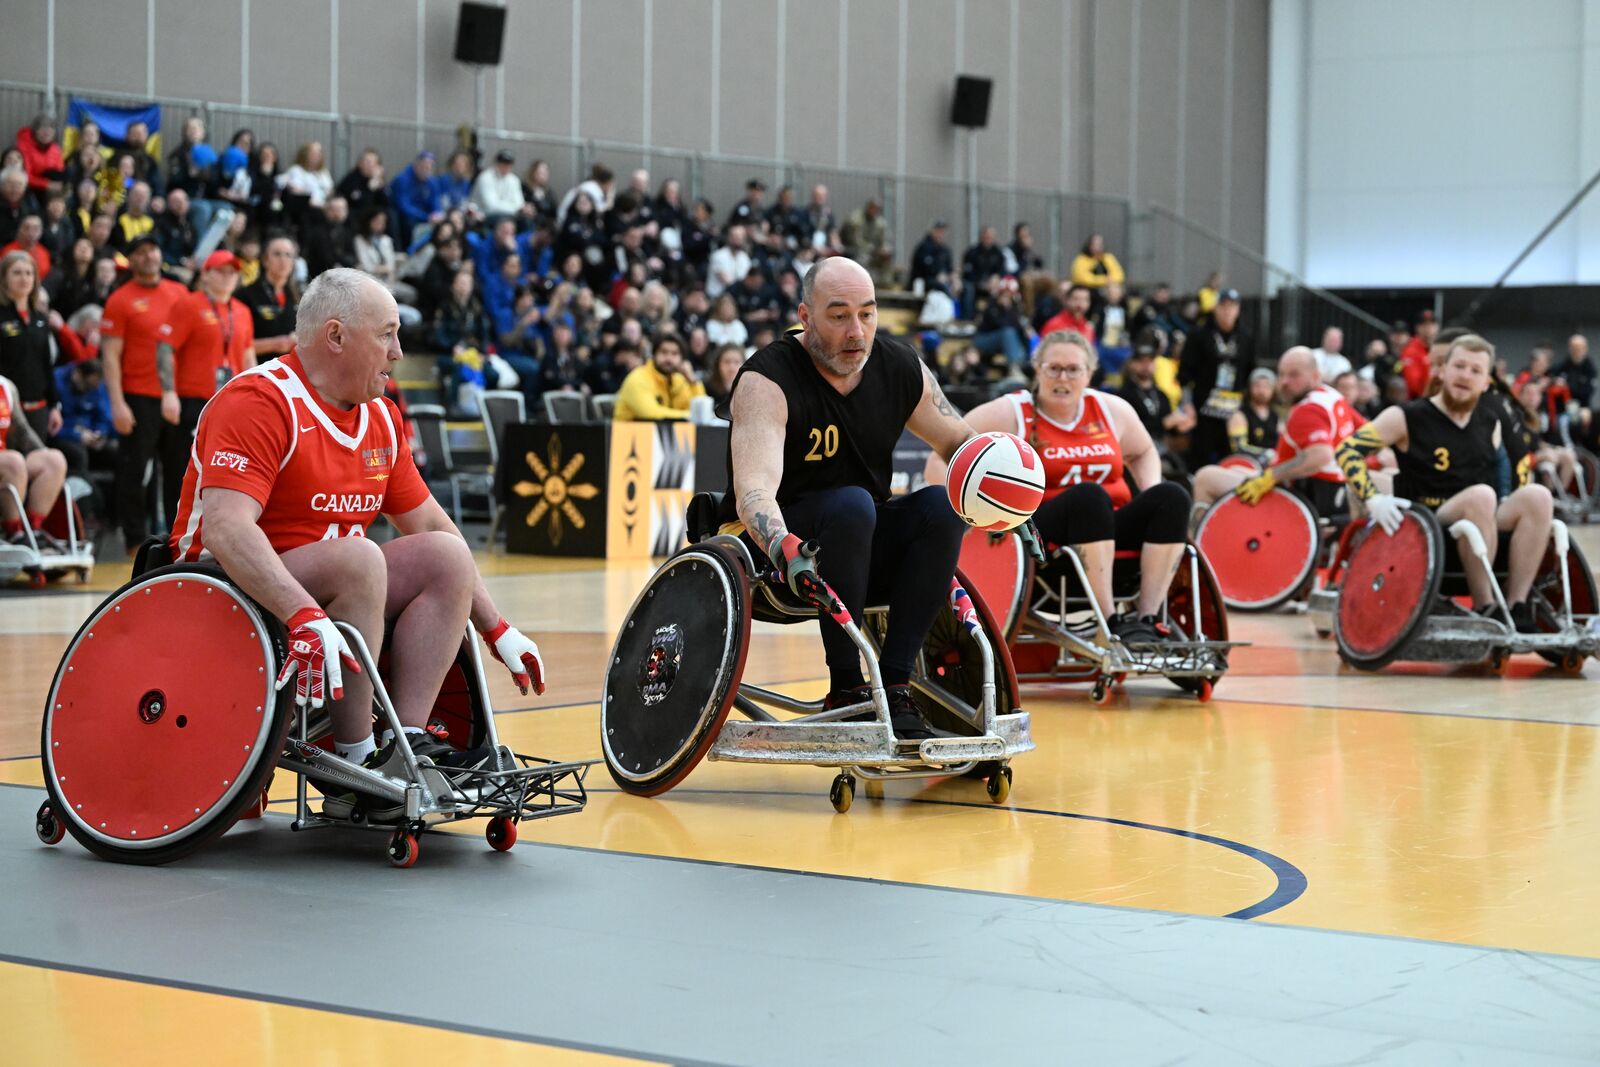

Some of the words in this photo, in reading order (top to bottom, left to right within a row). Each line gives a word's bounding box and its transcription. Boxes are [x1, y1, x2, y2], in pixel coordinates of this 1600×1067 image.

[804, 424, 839, 461] 20
[1043, 443, 1116, 459] CANADA
[210, 455, 249, 472] LOVE
[1433, 447, 1450, 471] 3
[311, 493, 383, 512] CANADA
